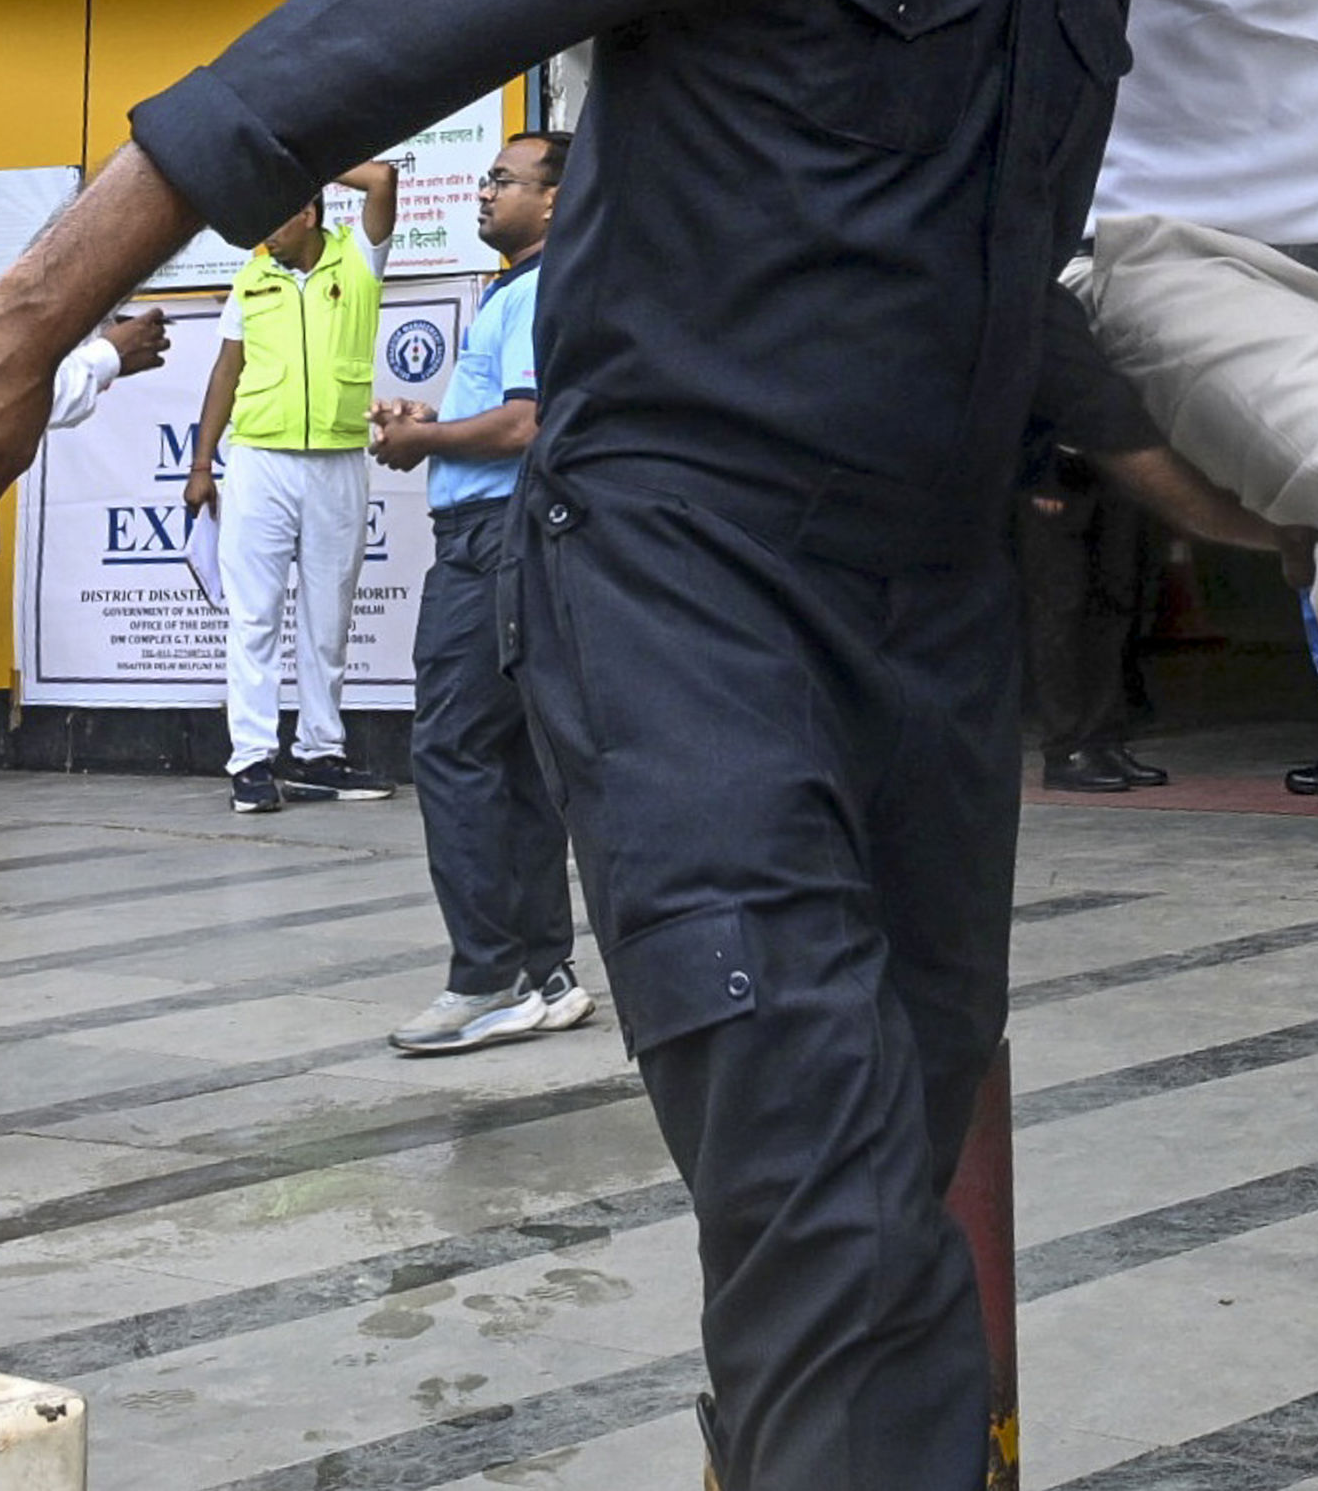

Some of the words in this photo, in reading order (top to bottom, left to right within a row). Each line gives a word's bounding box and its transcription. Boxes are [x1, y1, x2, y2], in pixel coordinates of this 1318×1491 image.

[81, 589, 144, 603] DISTRICT
[148, 588, 206, 603] DISASTE
[102, 607, 169, 617] GOVERNMENT
[171, 606, 184, 617] OF
[186, 606, 229, 616] NATIONA
[129, 620, 163, 631] OFFICE
[164, 620, 177, 630] OF
[179, 620, 198, 630] THE
[200, 619, 229, 630] DISTR
[110, 635, 126, 646] DM
[128, 634, 172, 645] COMPLEX
